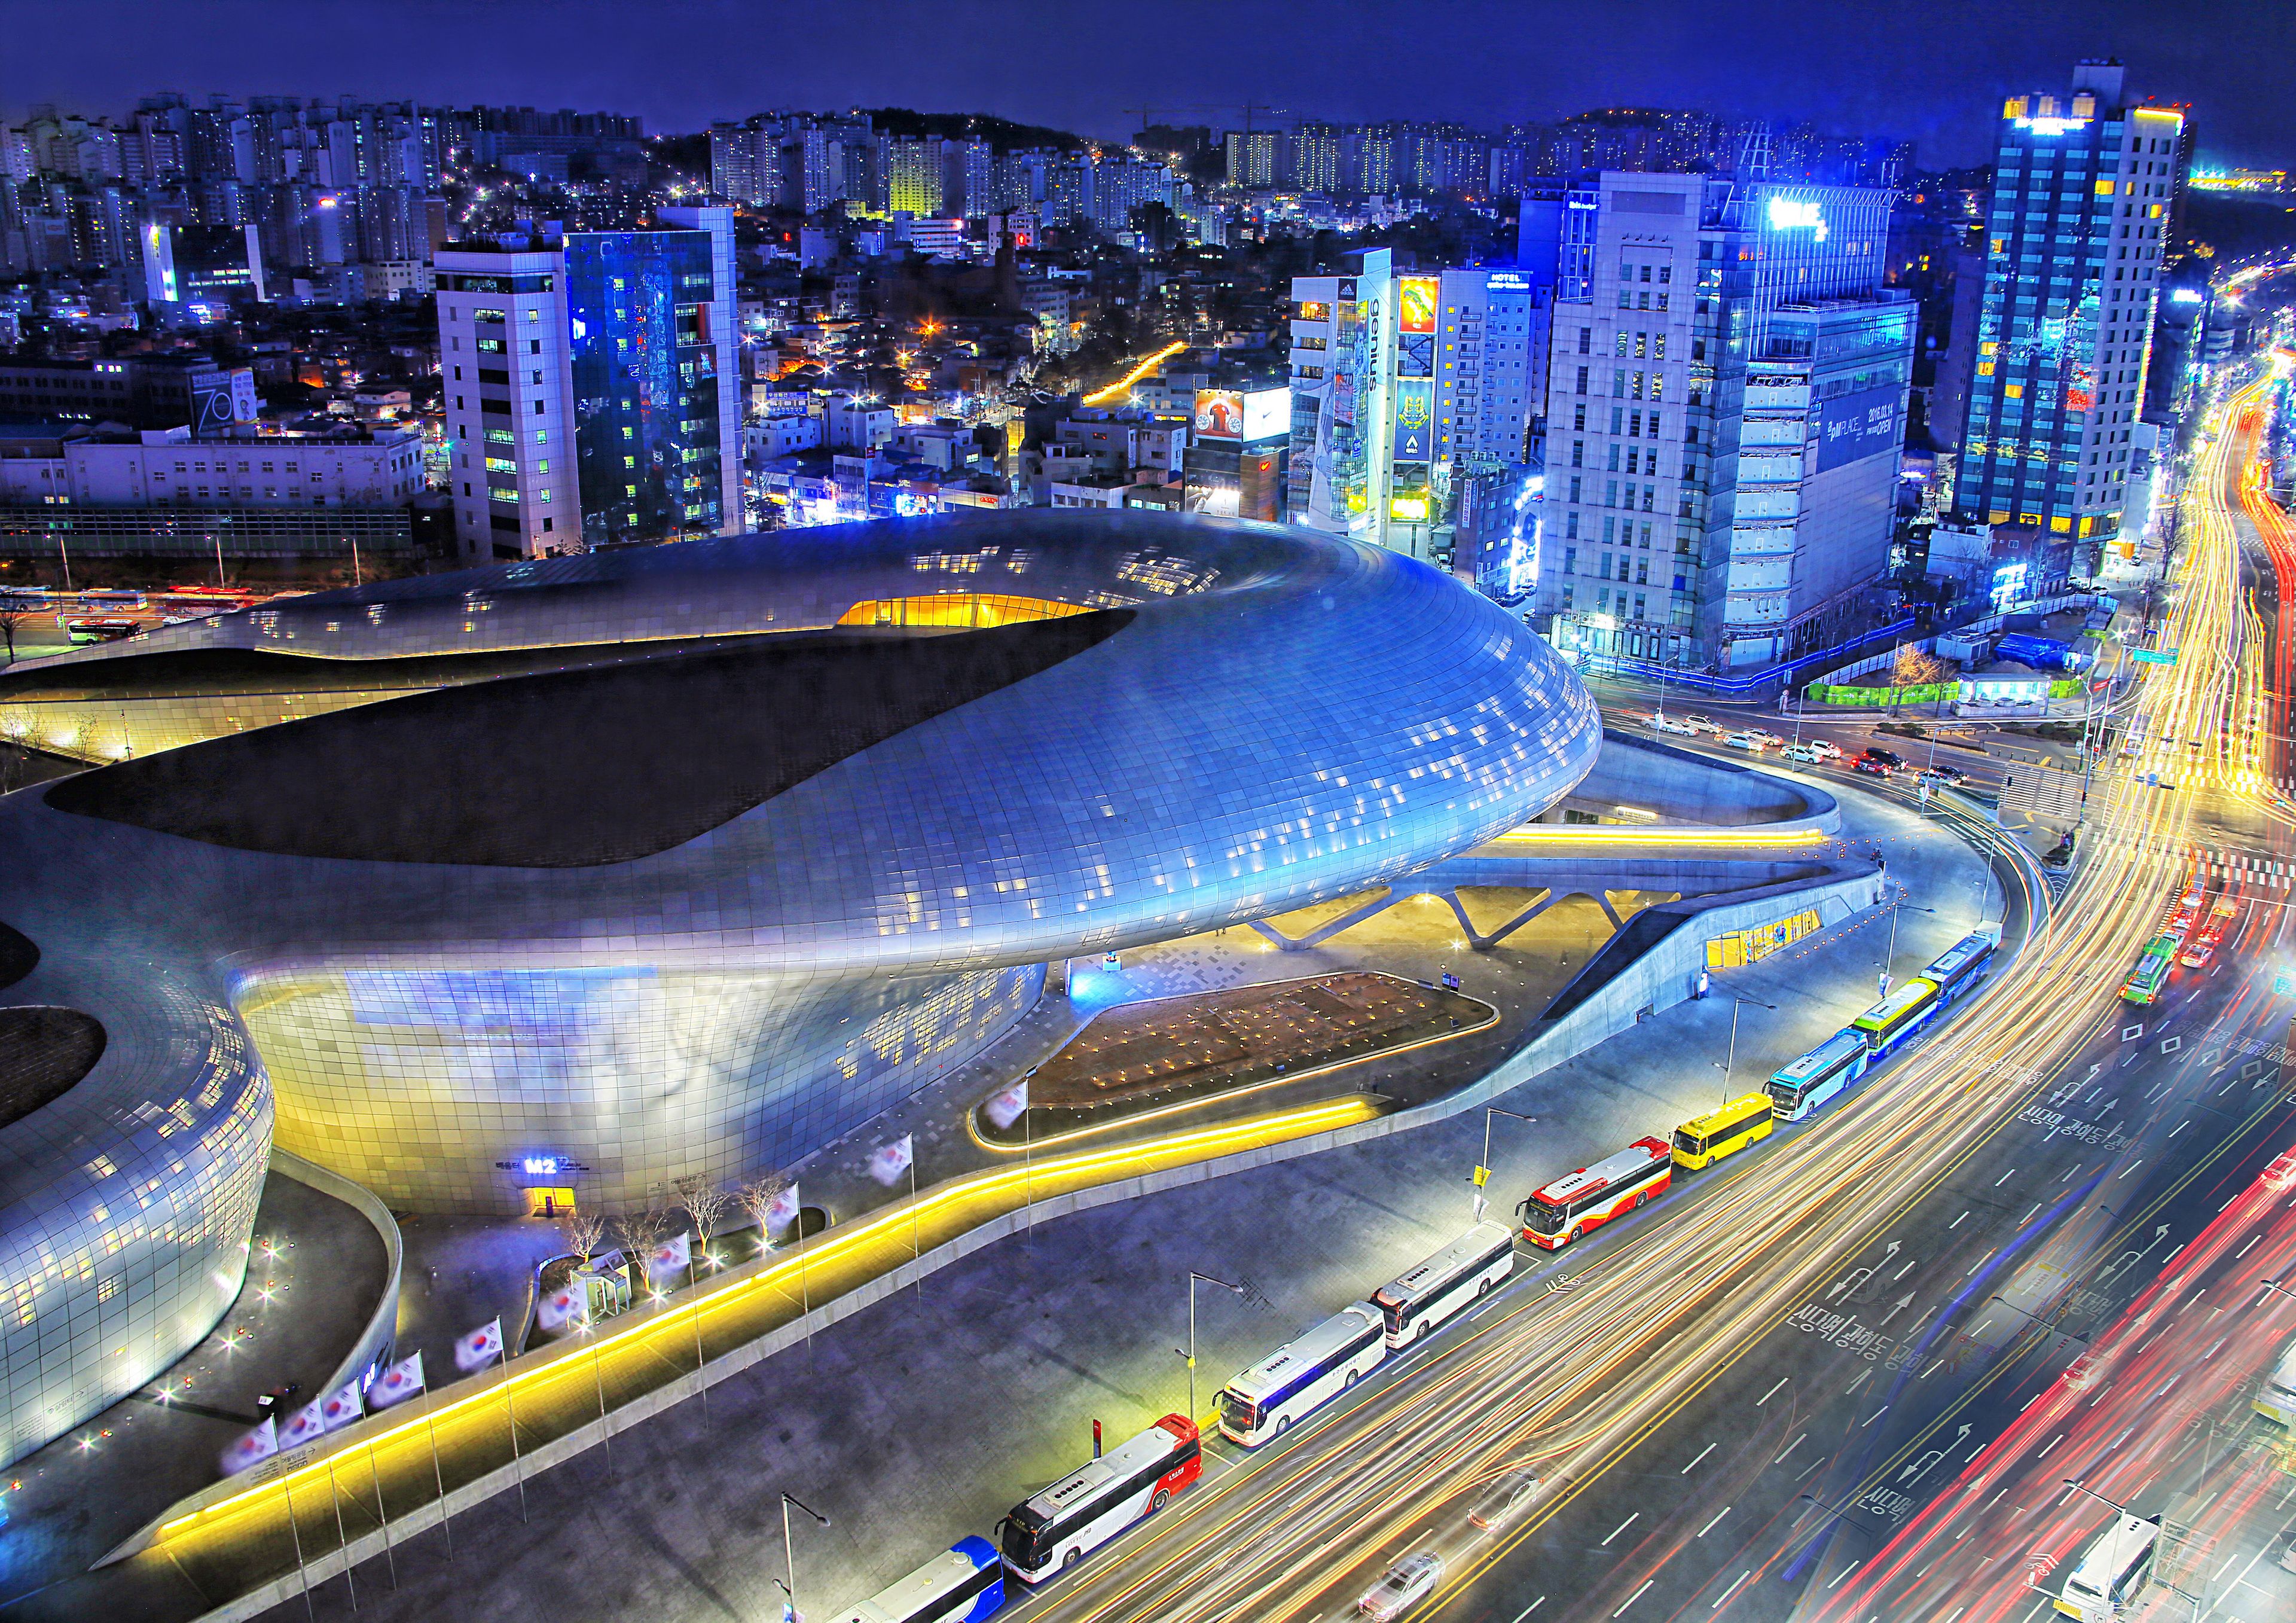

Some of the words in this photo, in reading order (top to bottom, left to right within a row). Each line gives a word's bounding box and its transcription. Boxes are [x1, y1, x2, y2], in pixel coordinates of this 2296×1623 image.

[1491, 273, 1521, 282] HOTEL
[1369, 298, 1379, 392] genius
[193, 388, 232, 432] 70
[1868, 402, 1894, 423] 2016.03.14
[1841, 416, 1860, 436] PLACE
[1876, 418, 1892, 436] OPEN
[524, 1158, 557, 1174] M2
[1785, 1303, 1846, 1339] 신당역
[1835, 1323, 1894, 1360] 광희동
[1857, 1486, 1916, 1522] 신당역
[1065, 1534, 1083, 1548] LOTTE
